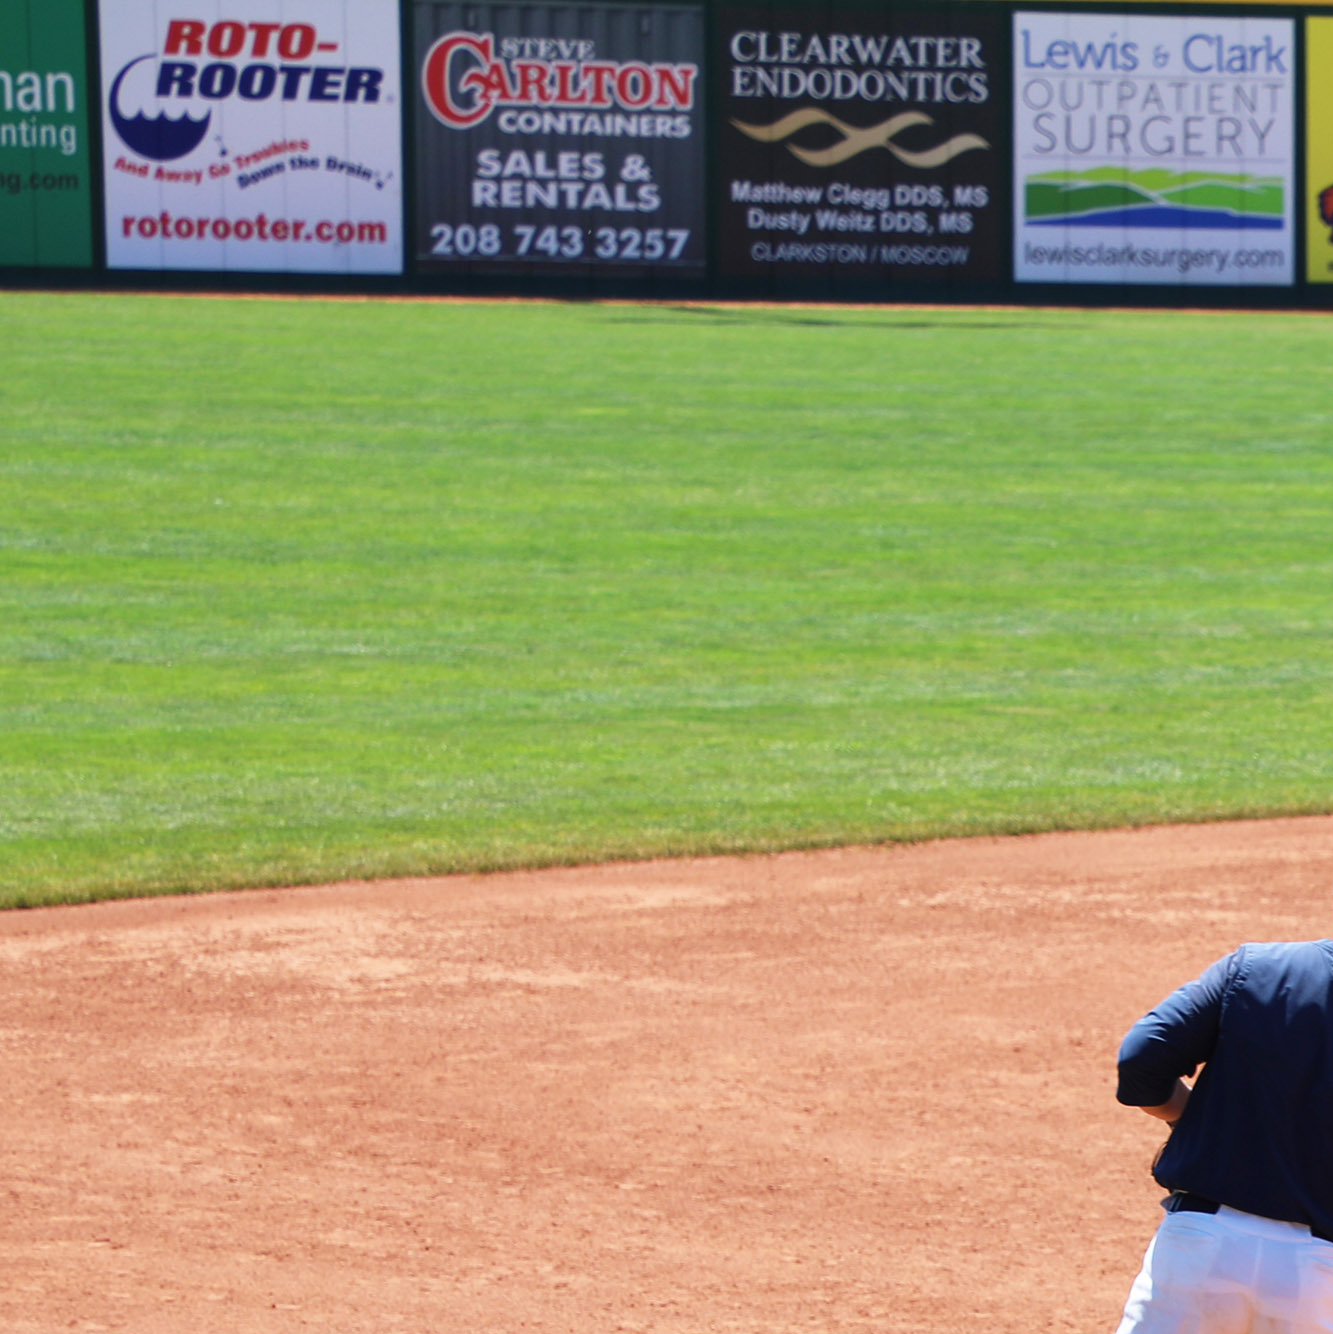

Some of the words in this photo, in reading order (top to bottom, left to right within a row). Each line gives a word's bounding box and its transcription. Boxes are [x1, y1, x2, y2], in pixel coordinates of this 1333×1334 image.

[163, 19, 338, 59] ROTO-
[501, 37, 594, 59] STEVE
[730, 31, 986, 68] CLEARWATER
[1021, 29, 1138, 71] Lewis
[1152, 45, 1170, 68] &
[1182, 33, 1287, 74] Clark
[156, 61, 384, 103] ROOTER
[422, 30, 698, 130] CARLTON
[731, 66, 989, 103] ENDODONTICS
[1022, 78, 1283, 115] OUTPATIENT
[498, 110, 692, 138] CONTAINERS
[1032, 112, 1275, 157] SURGERY
[114, 156, 149, 178] And
[154, 166, 202, 184] Away
[208, 164, 230, 179] Go
[234, 139, 309, 169] Troubles
[236, 161, 285, 189] Down
[289, 155, 320, 170] the
[476, 148, 605, 180] SALES
[620, 154, 652, 182] &
[472, 179, 661, 212] RENTALS
[731, 181, 823, 204] Matthew
[827, 183, 890, 210] Clegg
[894, 185, 949, 207] DDS,
[953, 185, 989, 207] MS
[121, 210, 387, 242] rotorooter.com
[747, 208, 811, 235] Dusty
[815, 210, 876, 232] Weitz
[879, 212, 934, 236] DDS,
[938, 212, 974, 233] MS
[431, 223, 501, 256] 208
[514, 225, 584, 258] 743
[595, 227, 690, 260] 3257
[751, 242, 866, 262] CLARKSTON
[880, 245, 970, 265] MOSCOW
[1024, 241, 1285, 273] lewisclarksurgery.com
